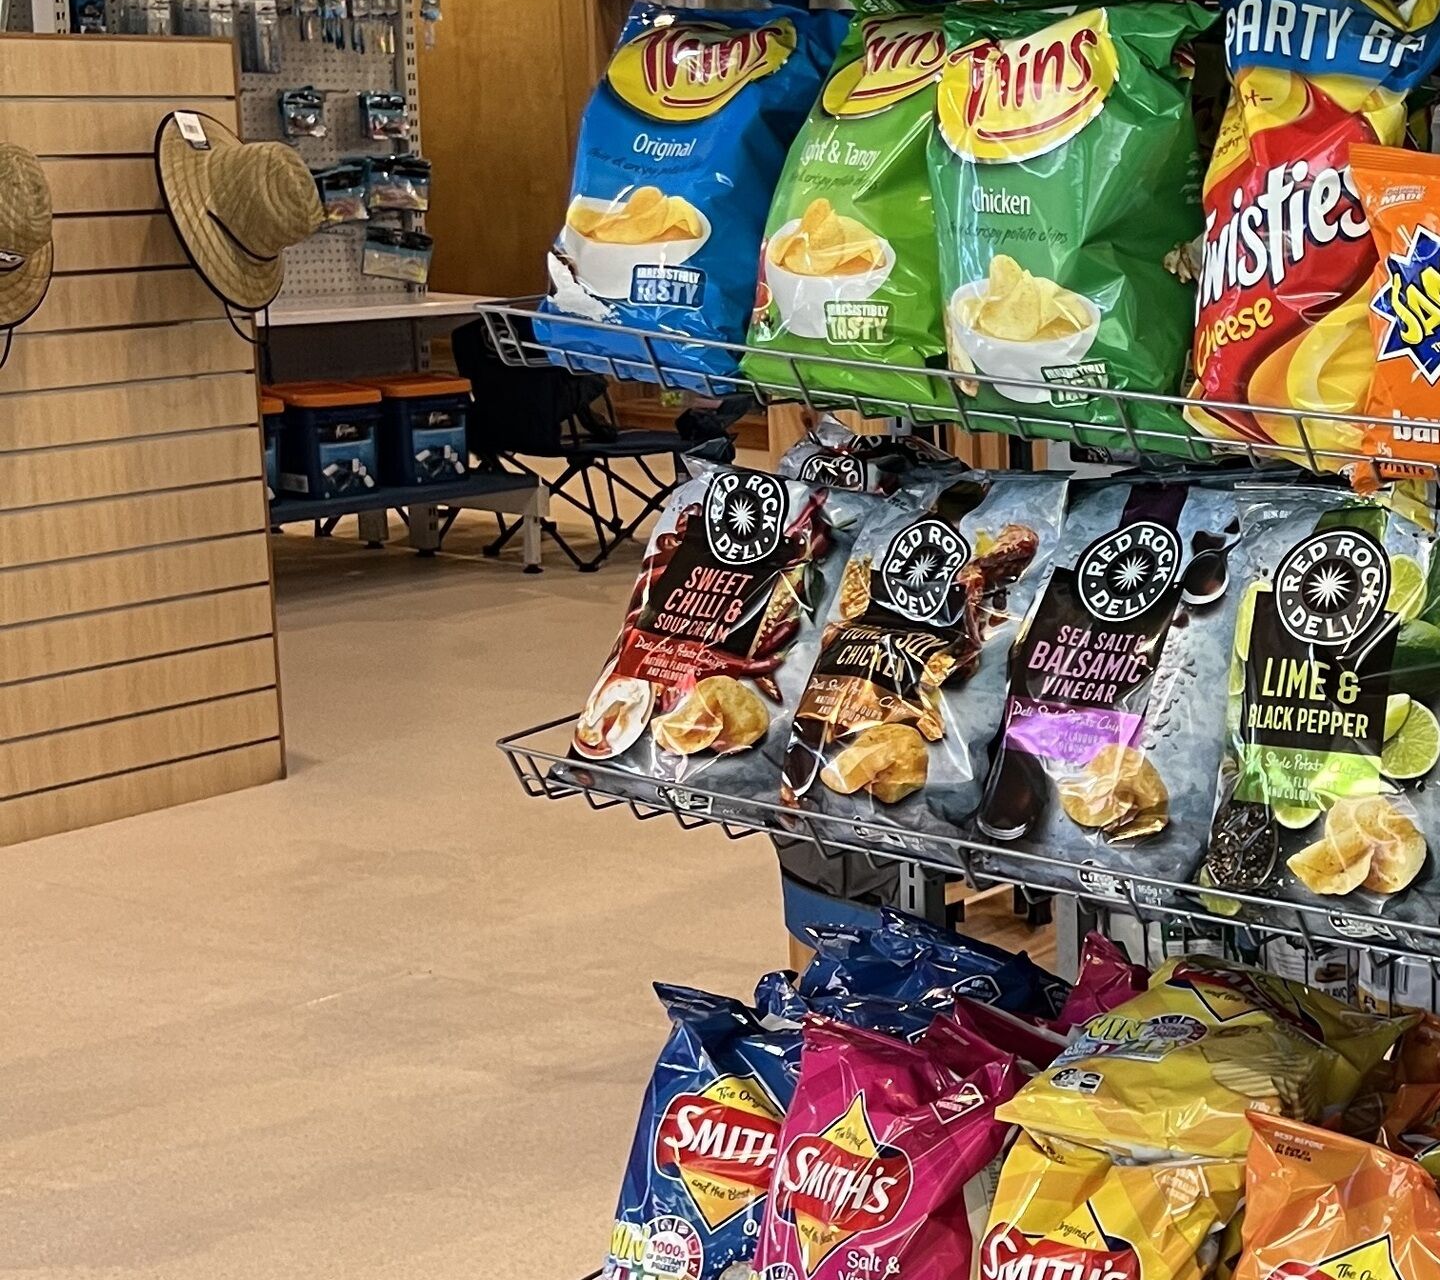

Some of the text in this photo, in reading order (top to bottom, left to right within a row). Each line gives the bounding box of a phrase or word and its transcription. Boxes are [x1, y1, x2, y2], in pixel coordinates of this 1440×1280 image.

[635, 24, 783, 95] Thins
[950, 28, 1098, 126] Thins
[632, 132, 697, 162] Original
[845, 144, 882, 171] Tangy
[971, 184, 1032, 217] Chicken
[1380, 191, 1424, 206] MADE
[636, 279, 699, 304] TASTY
[826, 301, 890, 318] IRRESISTIBLY
[828, 315, 889, 342] TASTY
[1196, 297, 1274, 378] Cheese
[711, 474, 776, 533] RED ROCK
[714, 535, 763, 562] DELI
[889, 525, 962, 581] RED ROCK
[1086, 526, 1169, 583] RED ROCK
[684, 566, 754, 597] SWEET
[1281, 538, 1381, 607] RED ROCK
[664, 588, 725, 619] CHILLI
[894, 585, 940, 619] DELI
[1090, 591, 1148, 617] DELI
[653, 614, 689, 636] SOUR
[1057, 625, 1135, 653] SEA SALT
[1289, 611, 1354, 638] DELI
[1028, 640, 1149, 684] BALSAMIC
[1040, 675, 1117, 704] VINEGAR
[1262, 657, 1362, 705] LIME &
[1248, 703, 1370, 739] BLACK PEPPER
[1273, 1130, 1326, 1149] BEST BEFORE
[788, 1147, 897, 1214] SMITH'S
[847, 1251, 882, 1273] Salt
[1335, 1263, 1358, 1280] The
